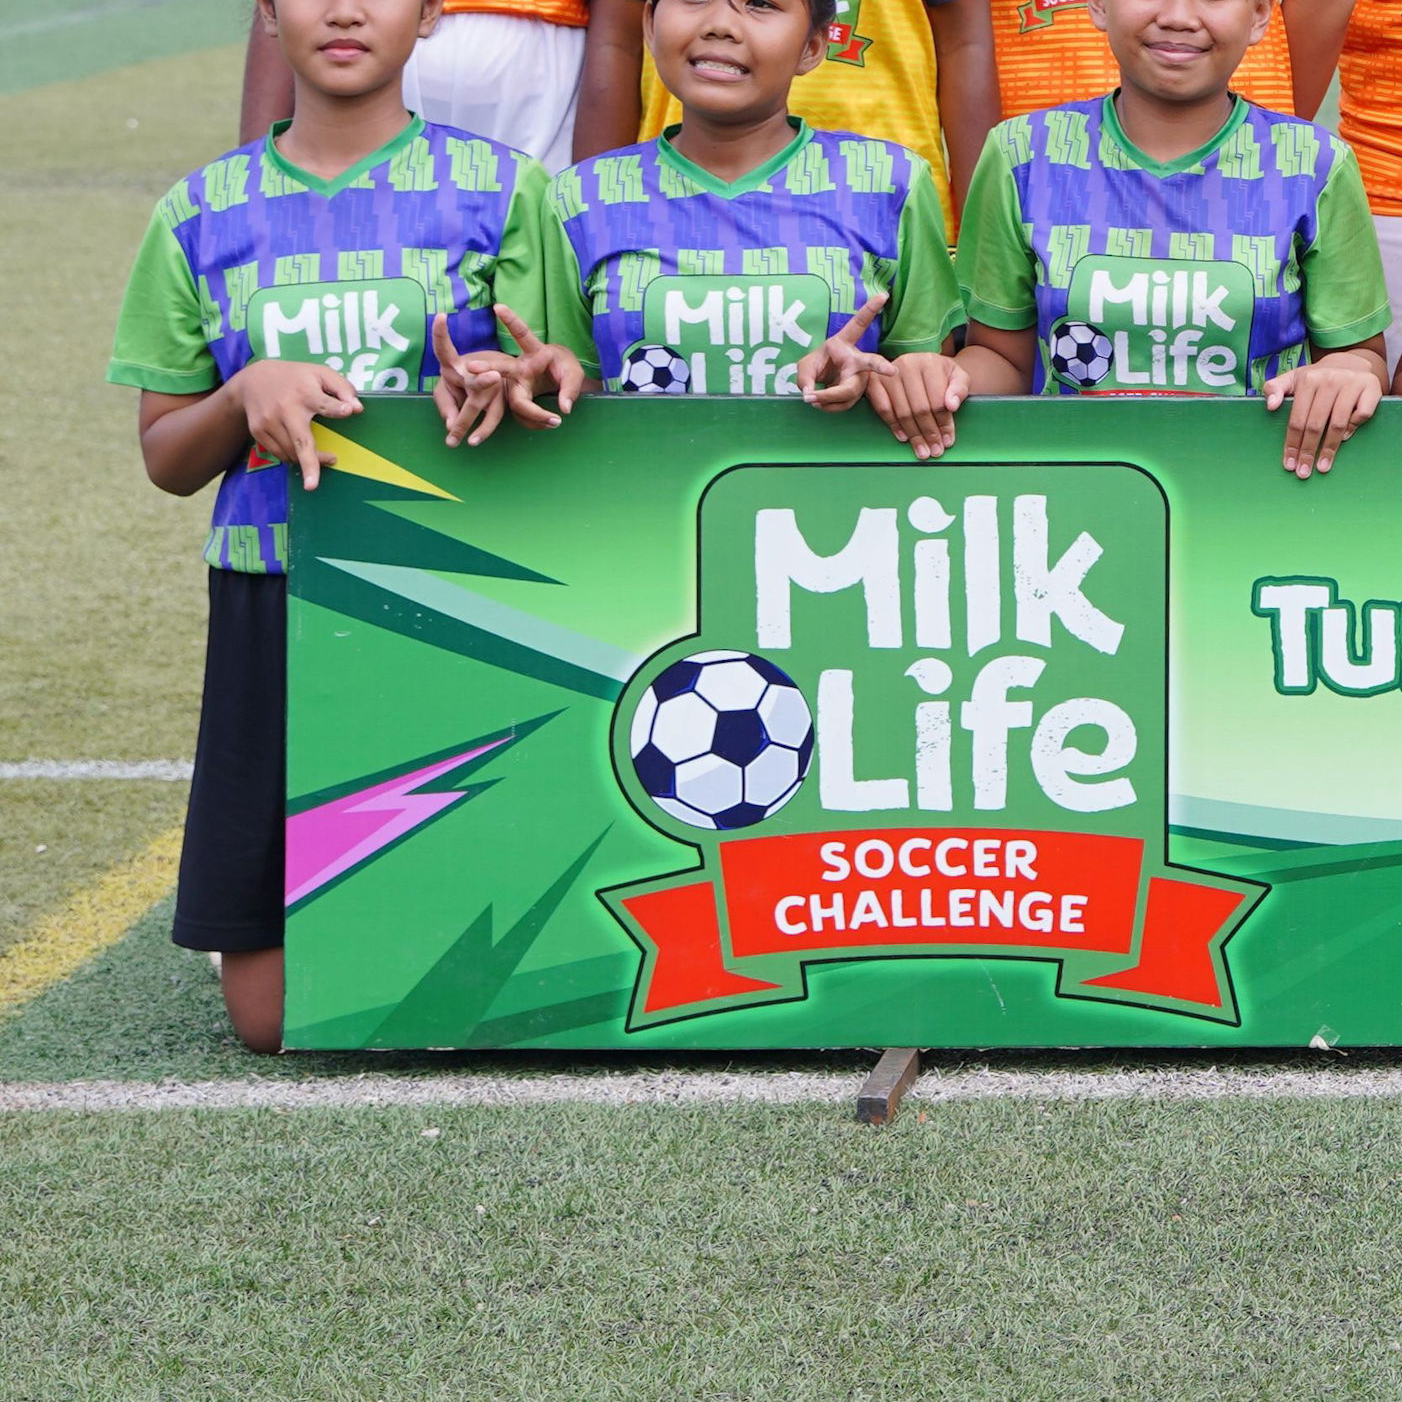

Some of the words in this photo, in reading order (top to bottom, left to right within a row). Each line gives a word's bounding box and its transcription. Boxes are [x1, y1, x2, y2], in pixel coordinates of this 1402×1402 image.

[263, 290, 410, 358] Milk
[665, 285, 813, 348] Milk
[1089, 269, 1236, 332] Milk
[1113, 329, 1238, 387] Life
[754, 494, 1126, 658] Milk
[816, 656, 1139, 814] Life
[819, 837, 1039, 882] SOCCER
[773, 890, 1090, 936] CHALLENGE
